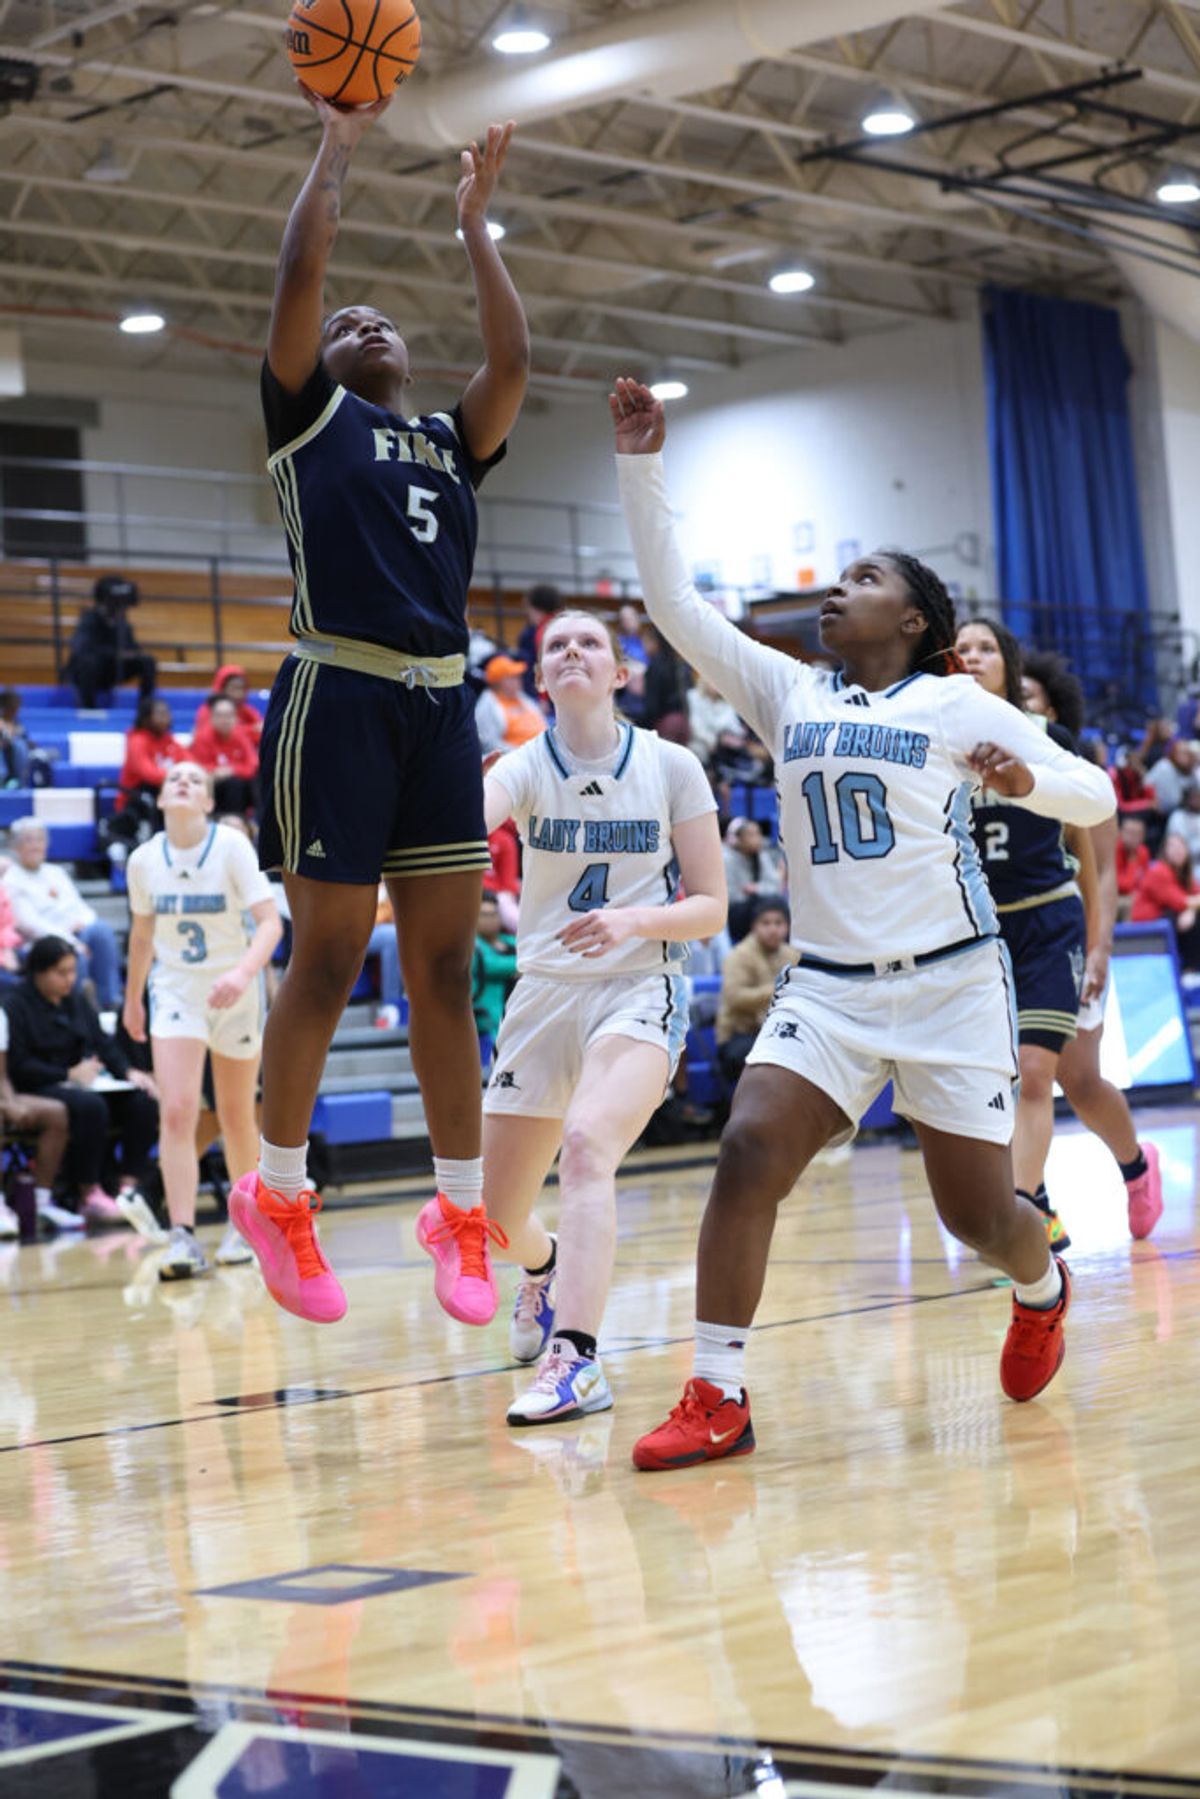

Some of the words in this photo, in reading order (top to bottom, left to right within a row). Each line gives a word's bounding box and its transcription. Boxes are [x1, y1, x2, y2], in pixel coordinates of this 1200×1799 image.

[407, 484, 440, 543] 5
[783, 721, 836, 764] LADY
[833, 721, 930, 770] BRUINS
[528, 815, 581, 853] LADY
[583, 819, 660, 854] BRUINS
[802, 771, 896, 865] 10
[567, 863, 610, 913] 4
[177, 920, 208, 965] 3
